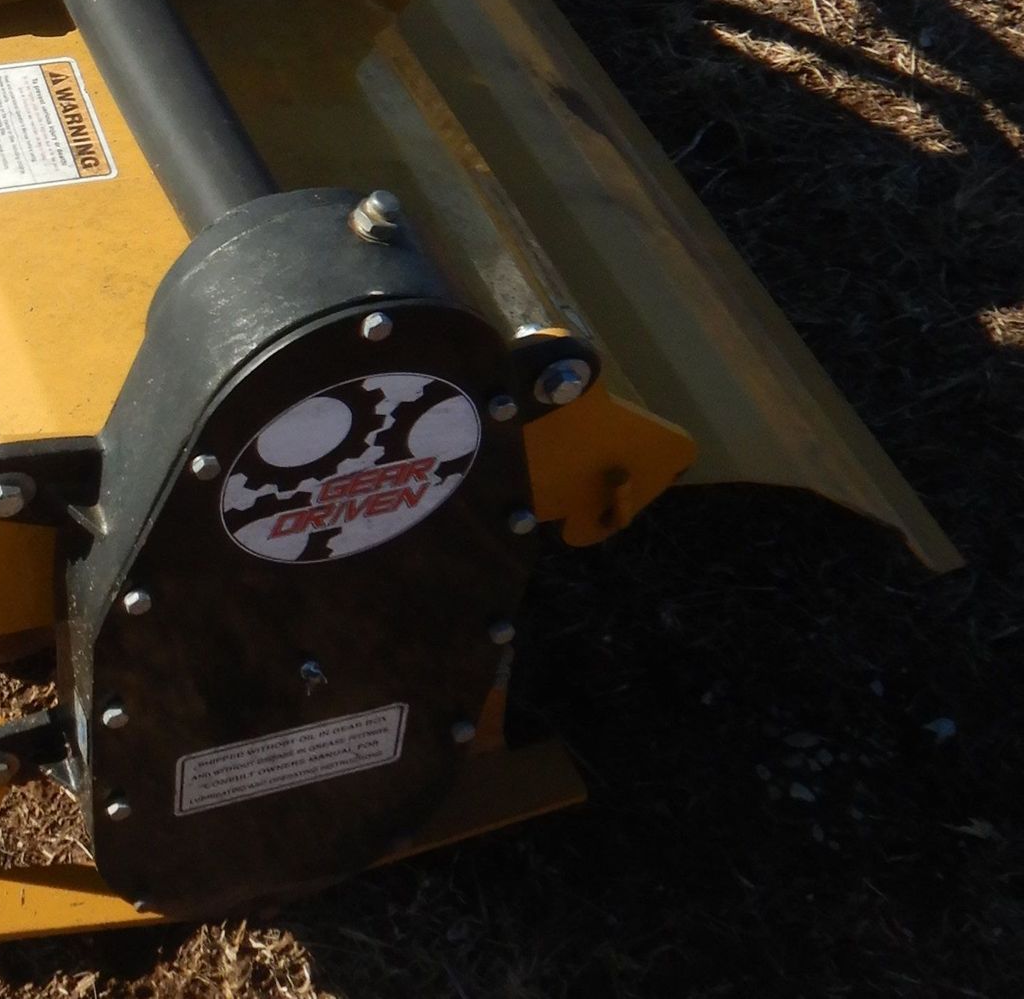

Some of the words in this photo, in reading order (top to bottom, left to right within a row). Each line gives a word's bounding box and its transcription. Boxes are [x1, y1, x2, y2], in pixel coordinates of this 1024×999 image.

[53, 86, 100, 169] WARNING
[316, 456, 438, 503] GEAR
[267, 482, 431, 540] DRIVEN
